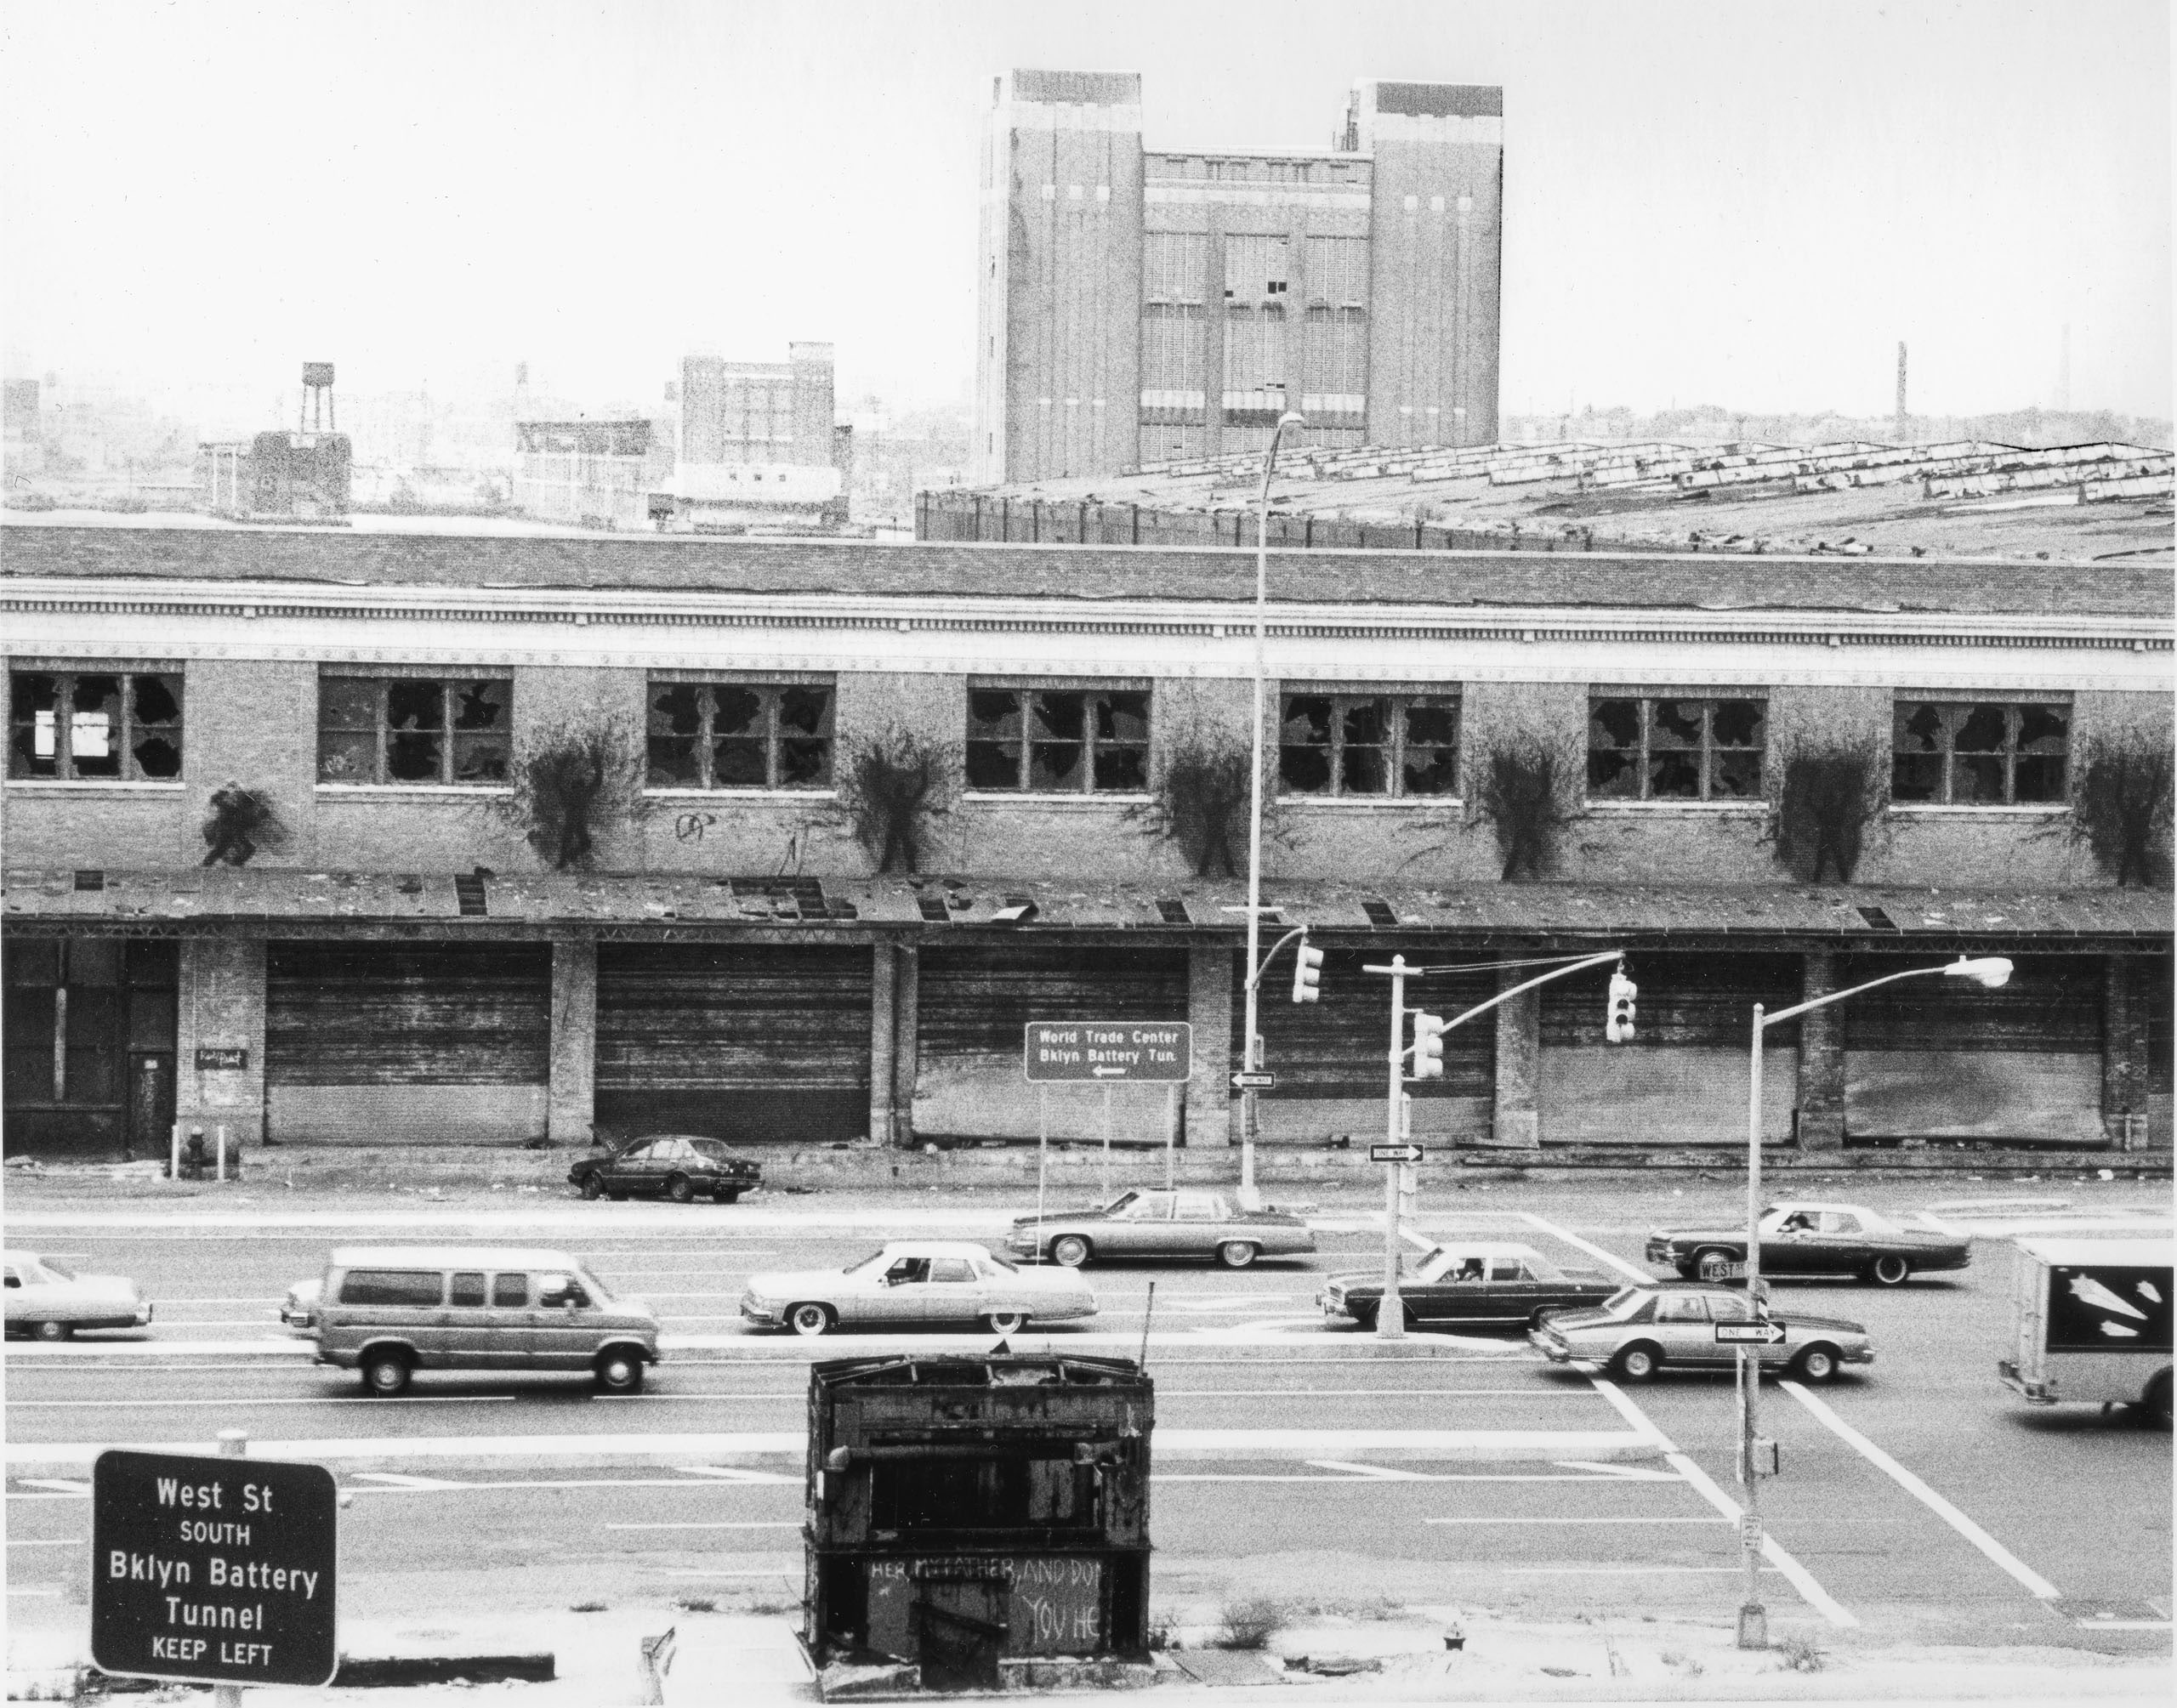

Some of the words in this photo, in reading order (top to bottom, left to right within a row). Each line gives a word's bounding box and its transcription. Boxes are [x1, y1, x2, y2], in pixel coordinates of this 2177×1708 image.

[1039, 1030, 1077, 1043] World
[1085, 1030, 1123, 1043] Trade
[1132, 1030, 1179, 1044] Center
[1040, 1049, 1079, 1064] Bklyn
[1088, 1049, 1140, 1064] Battery
[1148, 1048, 1176, 1062] Tun.
[1702, 1263, 1733, 1277] WEST
[1721, 1328, 1741, 1336] ONE
[1755, 1328, 1776, 1336] WAY
[157, 1478, 223, 1509] West
[243, 1484, 273, 1512] St
[179, 1520, 250, 1546] SOUTH
[110, 1550, 190, 1589] Bklyn
[210, 1558, 318, 1599] Battery
[1023, 1558, 1065, 1584] AND
[166, 1597, 262, 1631] Tunnel
[1021, 1595, 1066, 1645] YOU
[151, 1637, 207, 1660] KEEP
[221, 1642, 273, 1666] LEFT
